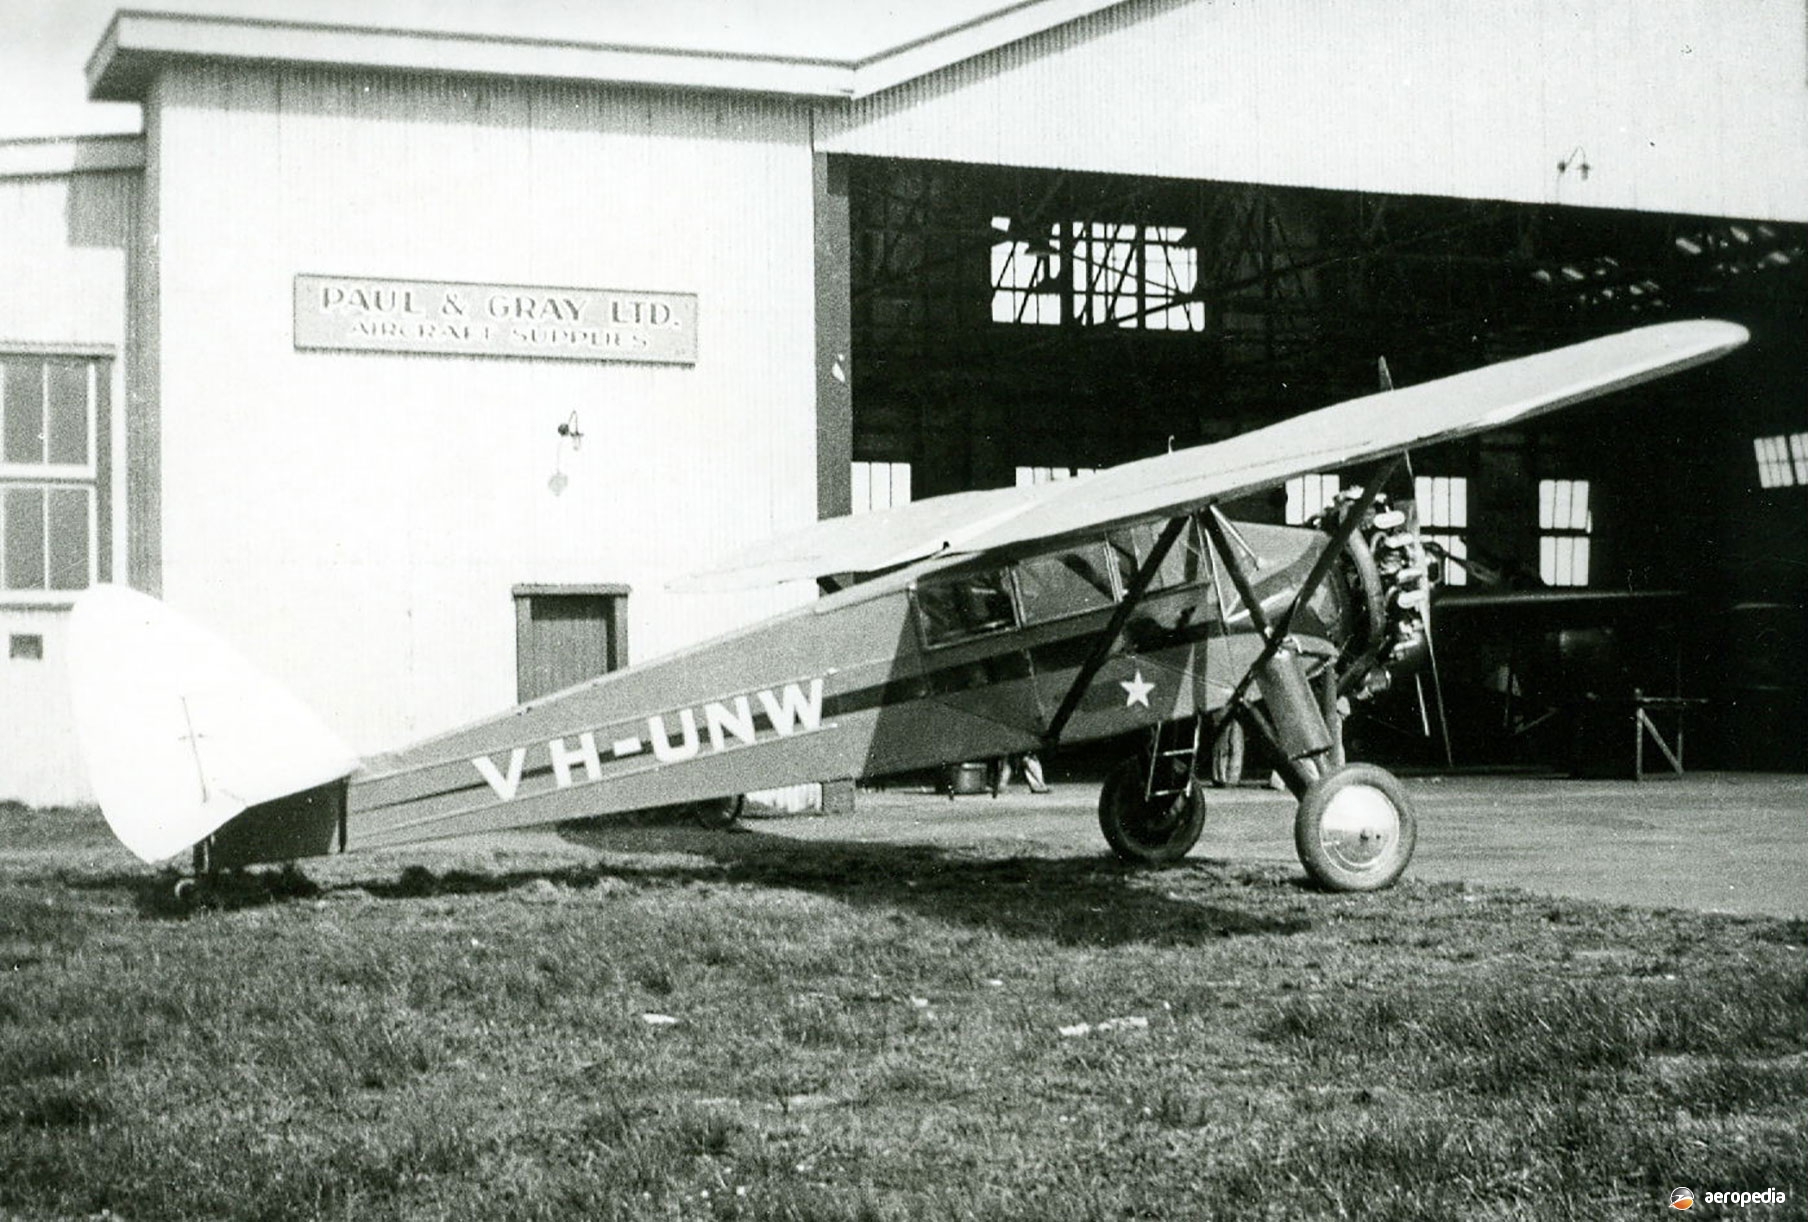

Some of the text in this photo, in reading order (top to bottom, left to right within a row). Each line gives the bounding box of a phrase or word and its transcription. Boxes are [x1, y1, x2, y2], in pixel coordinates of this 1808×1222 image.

[321, 286, 682, 327] PAUL & GRAY LTD.
[350, 319, 495, 341] AIRCRAFT
[472, 679, 823, 800] VH-UNW
